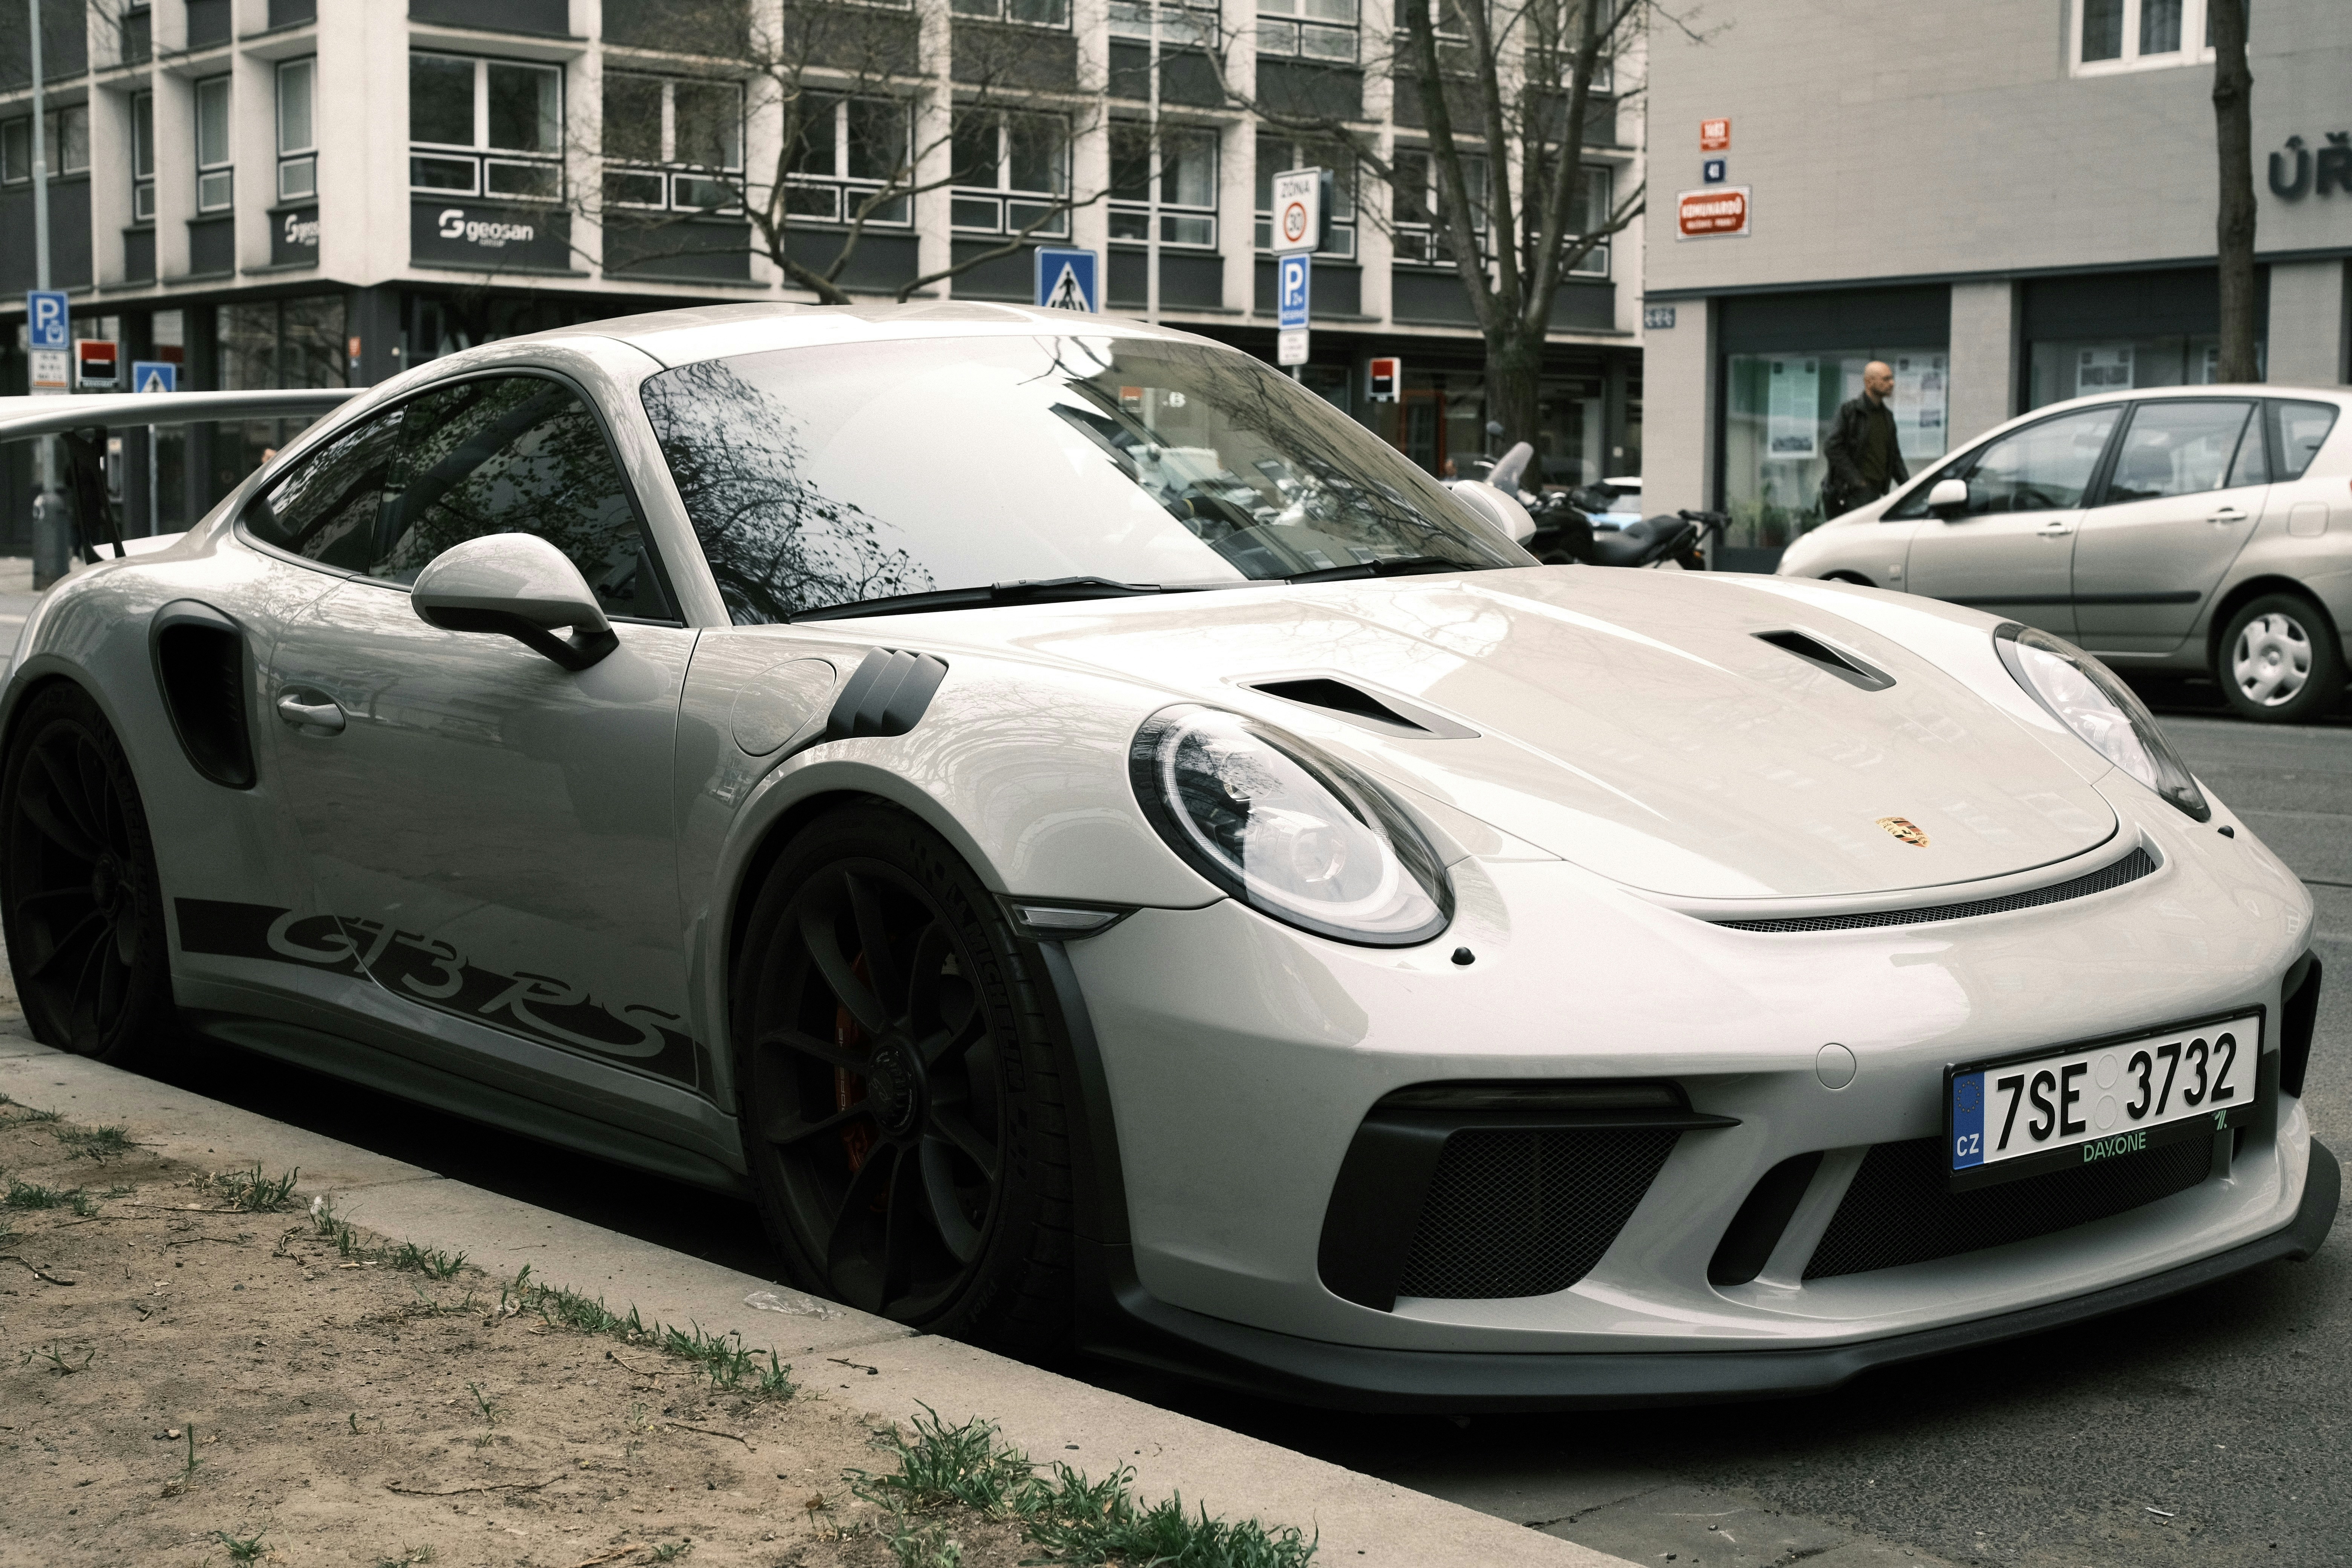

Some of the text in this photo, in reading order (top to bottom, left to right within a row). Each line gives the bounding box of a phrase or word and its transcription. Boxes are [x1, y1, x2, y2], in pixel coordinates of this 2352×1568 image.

[466, 220, 534, 242] geosan
[1288, 213, 1303, 231] 30
[1284, 262, 1304, 307] P
[37, 297, 60, 331] P
[477, 971, 681, 1058] RS
[1996, 1032, 2237, 1151] 7SE 3732
[1957, 1133, 1980, 1157] CZ
